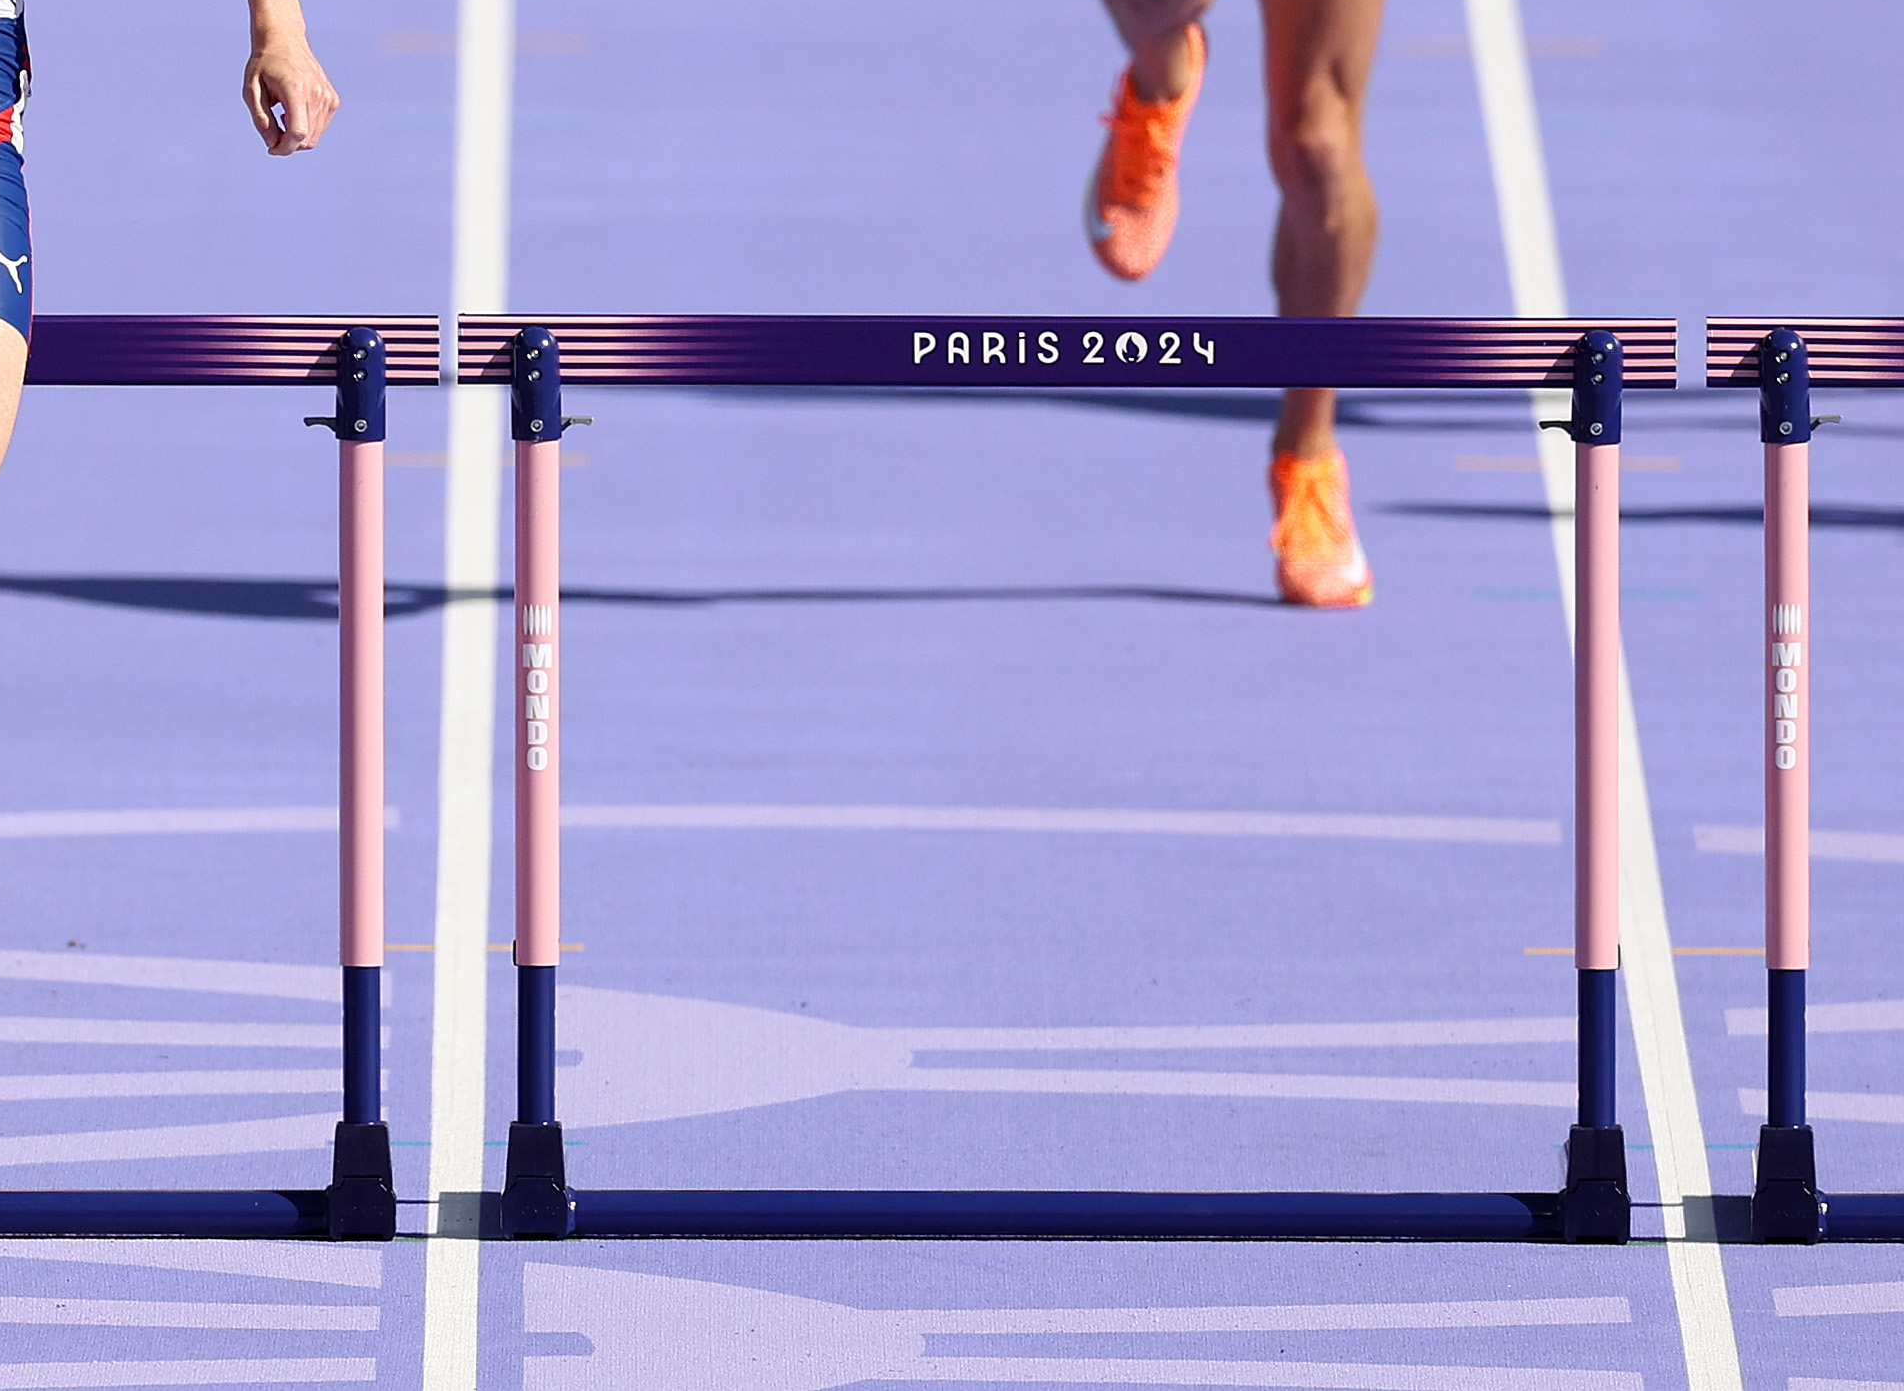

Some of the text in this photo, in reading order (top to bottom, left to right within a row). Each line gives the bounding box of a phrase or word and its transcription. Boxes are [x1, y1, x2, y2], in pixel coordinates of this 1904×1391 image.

[1082, 331, 1215, 365] 2024
[522, 643, 553, 771] MONDO
[1771, 642, 1802, 770] MONDO
